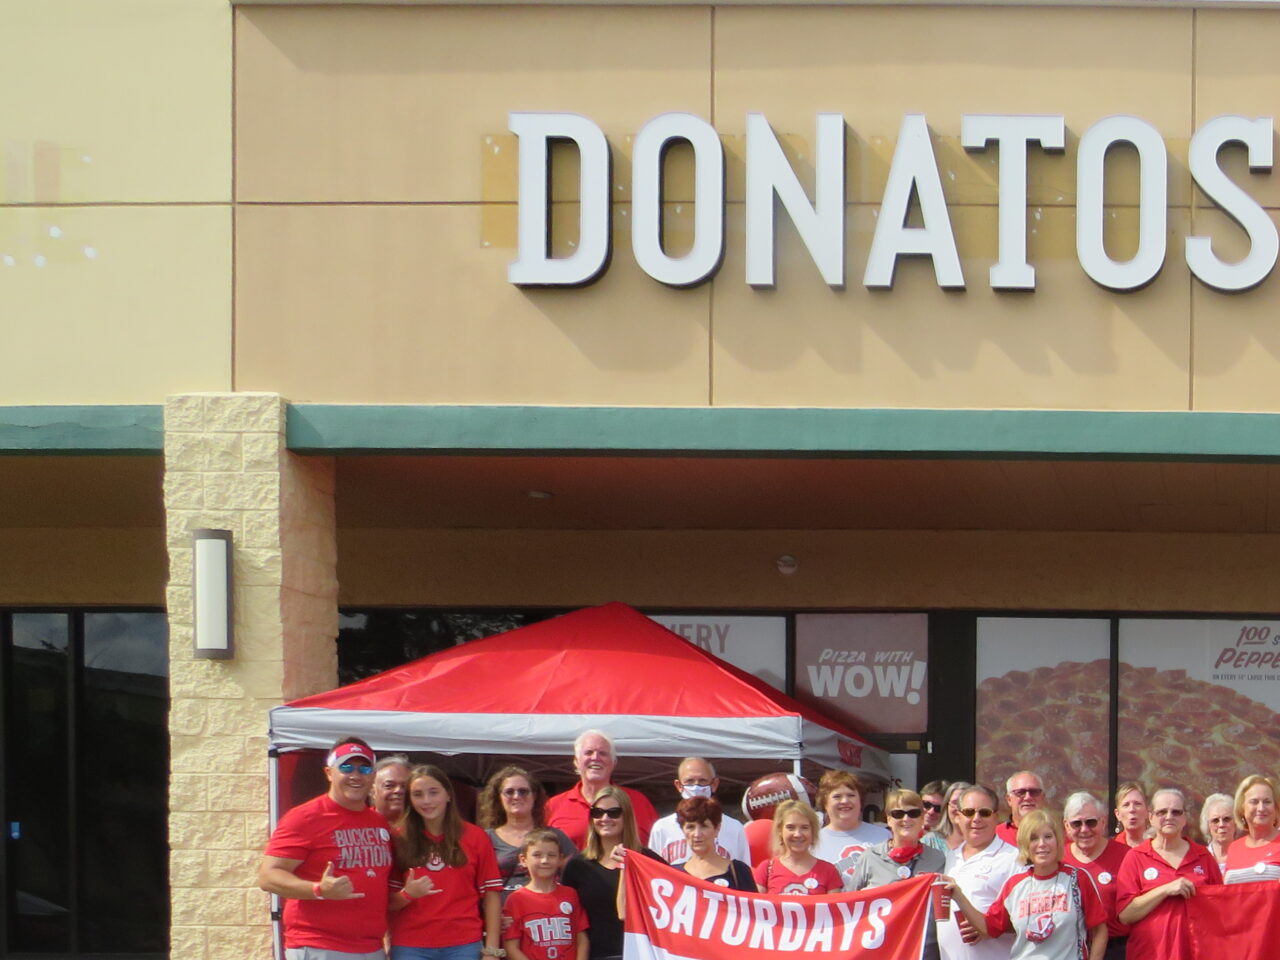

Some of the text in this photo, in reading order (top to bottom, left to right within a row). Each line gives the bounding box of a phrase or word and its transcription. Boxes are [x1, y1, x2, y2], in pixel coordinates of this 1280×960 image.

[507, 111, 1280, 292] DONATOS
[668, 623, 731, 654] ERY
[1235, 626, 1271, 647] 100
[807, 661, 927, 705] WOW!
[339, 845, 392, 869] NATION
[525, 917, 573, 942] THE
[649, 878, 892, 952] SATURDAYS
